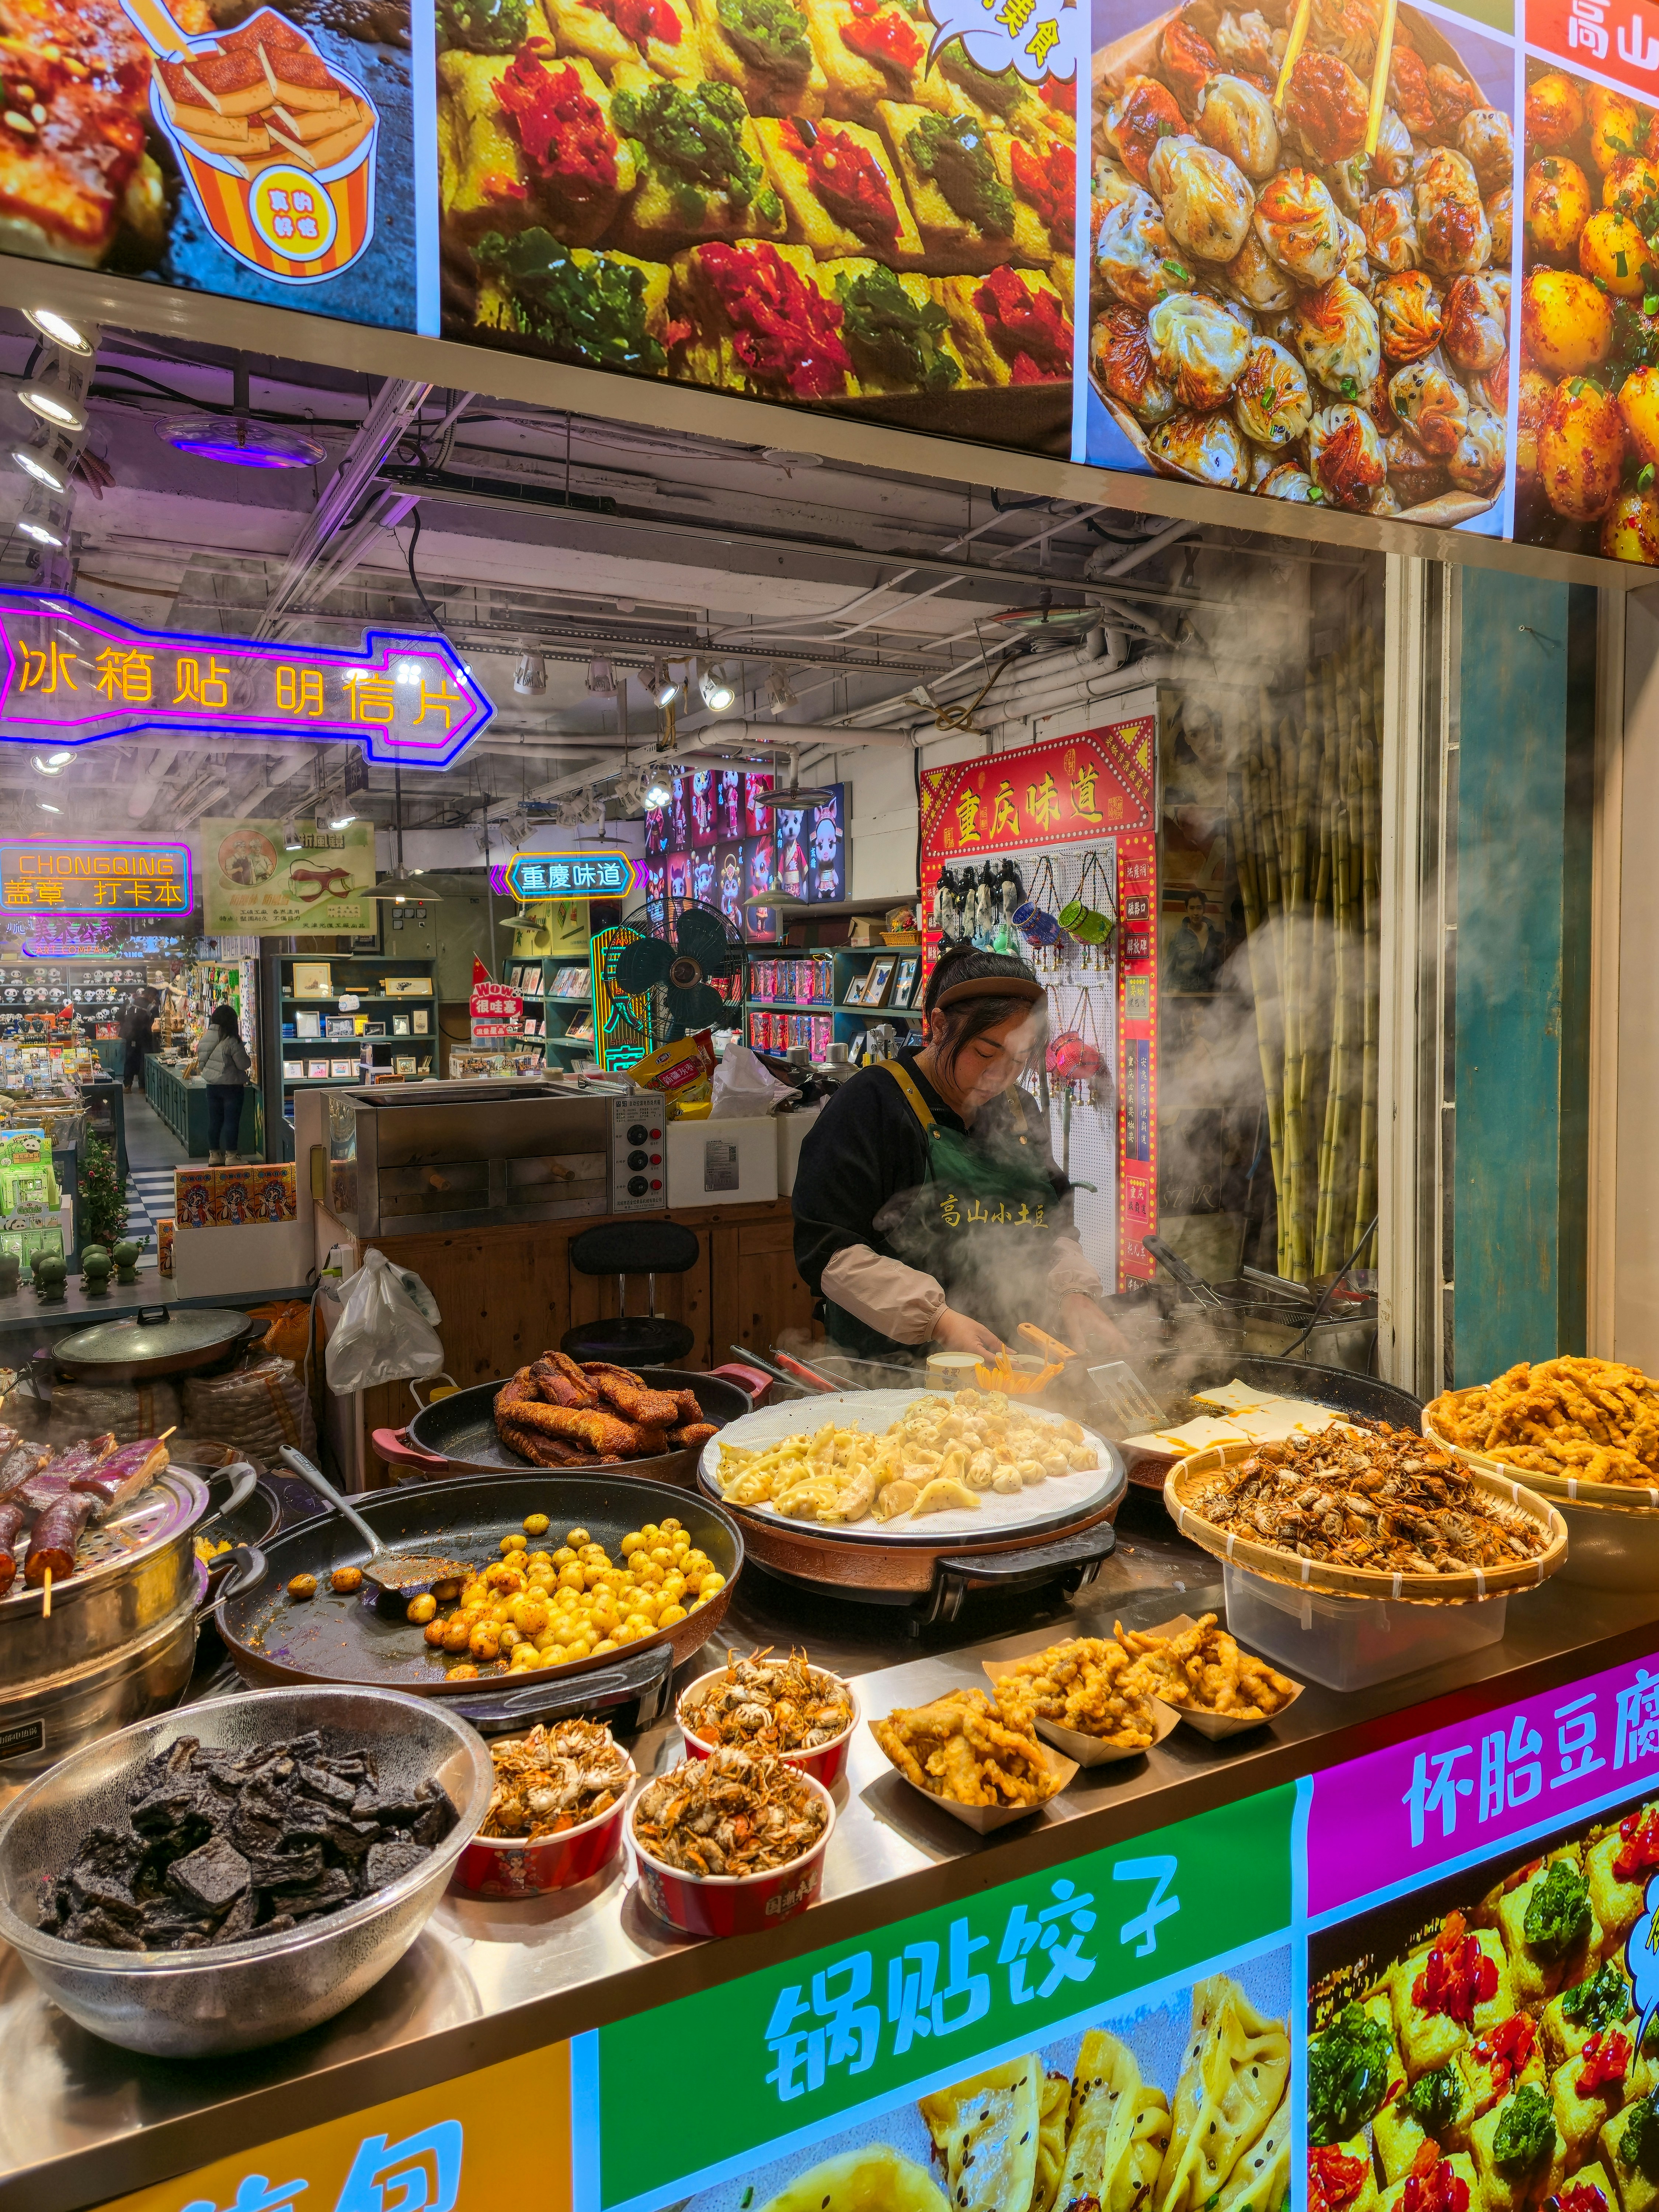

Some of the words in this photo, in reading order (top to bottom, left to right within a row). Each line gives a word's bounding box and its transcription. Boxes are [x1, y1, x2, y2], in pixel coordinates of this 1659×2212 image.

[981, 0, 1059, 68] 美食
[1569, 0, 1659, 71] 高山
[268, 188, 313, 212] 真的
[19, 640, 231, 708] 冰箱贴
[275, 665, 460, 729] 明信片
[955, 762, 1103, 847] 重庆味道
[19, 855, 174, 876] CHONGQING
[520, 863, 622, 890] 重慶味道
[1127, 863, 1147, 879] 洪崖洞
[4, 880, 65, 905] 盖章
[94, 880, 182, 907] 打卡本
[1128, 900, 1146, 916] 磁器口
[36, 946, 55, 954] ART
[62, 945, 112, 954] COMPAN
[1127, 937, 1147, 956] 解放碑
[476, 999, 517, 1013] 很哇塞
[662, 1062, 694, 1086] 新疆灰枣
[1130, 1185, 1145, 1200] 重庆
[1159, 1184, 1219, 1209] STAR
[940, 1194, 1049, 1229] 高山小土豆
[1402, 1668, 1659, 1848] 怀胎豆腐
[765, 1855, 1180, 2102] 锅贴饺子
